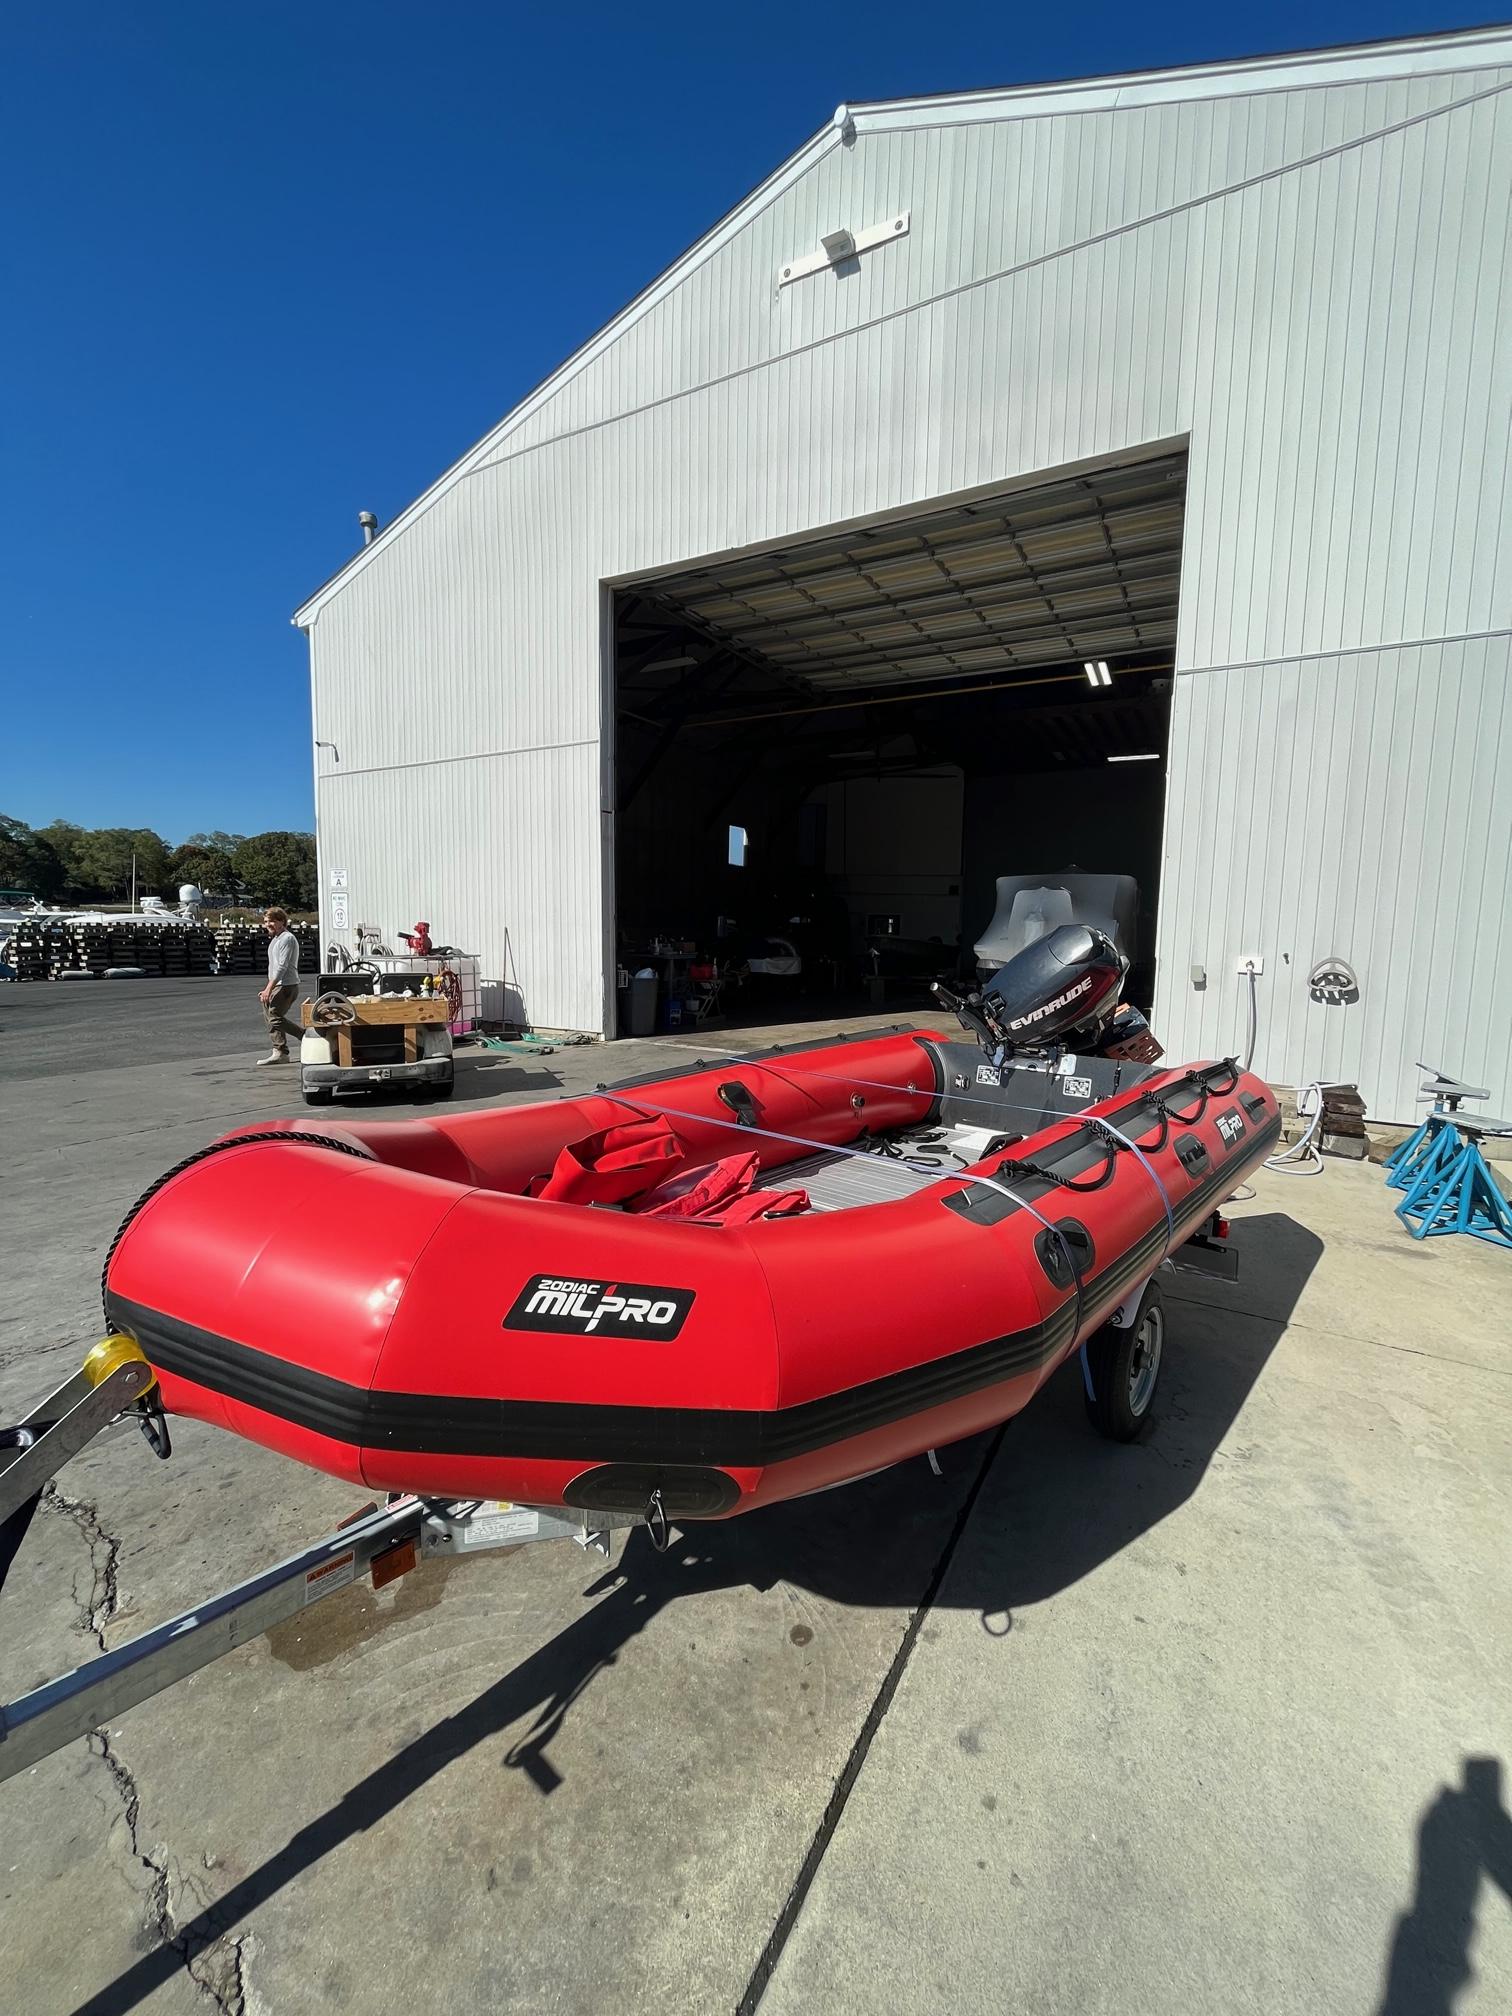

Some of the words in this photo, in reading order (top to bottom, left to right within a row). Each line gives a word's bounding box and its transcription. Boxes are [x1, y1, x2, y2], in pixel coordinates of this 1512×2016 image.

[1010, 976, 1093, 1031] EVINRUDE
[538, 1279, 601, 1295] ZODIAC
[524, 1289, 677, 1333] MILPRO
